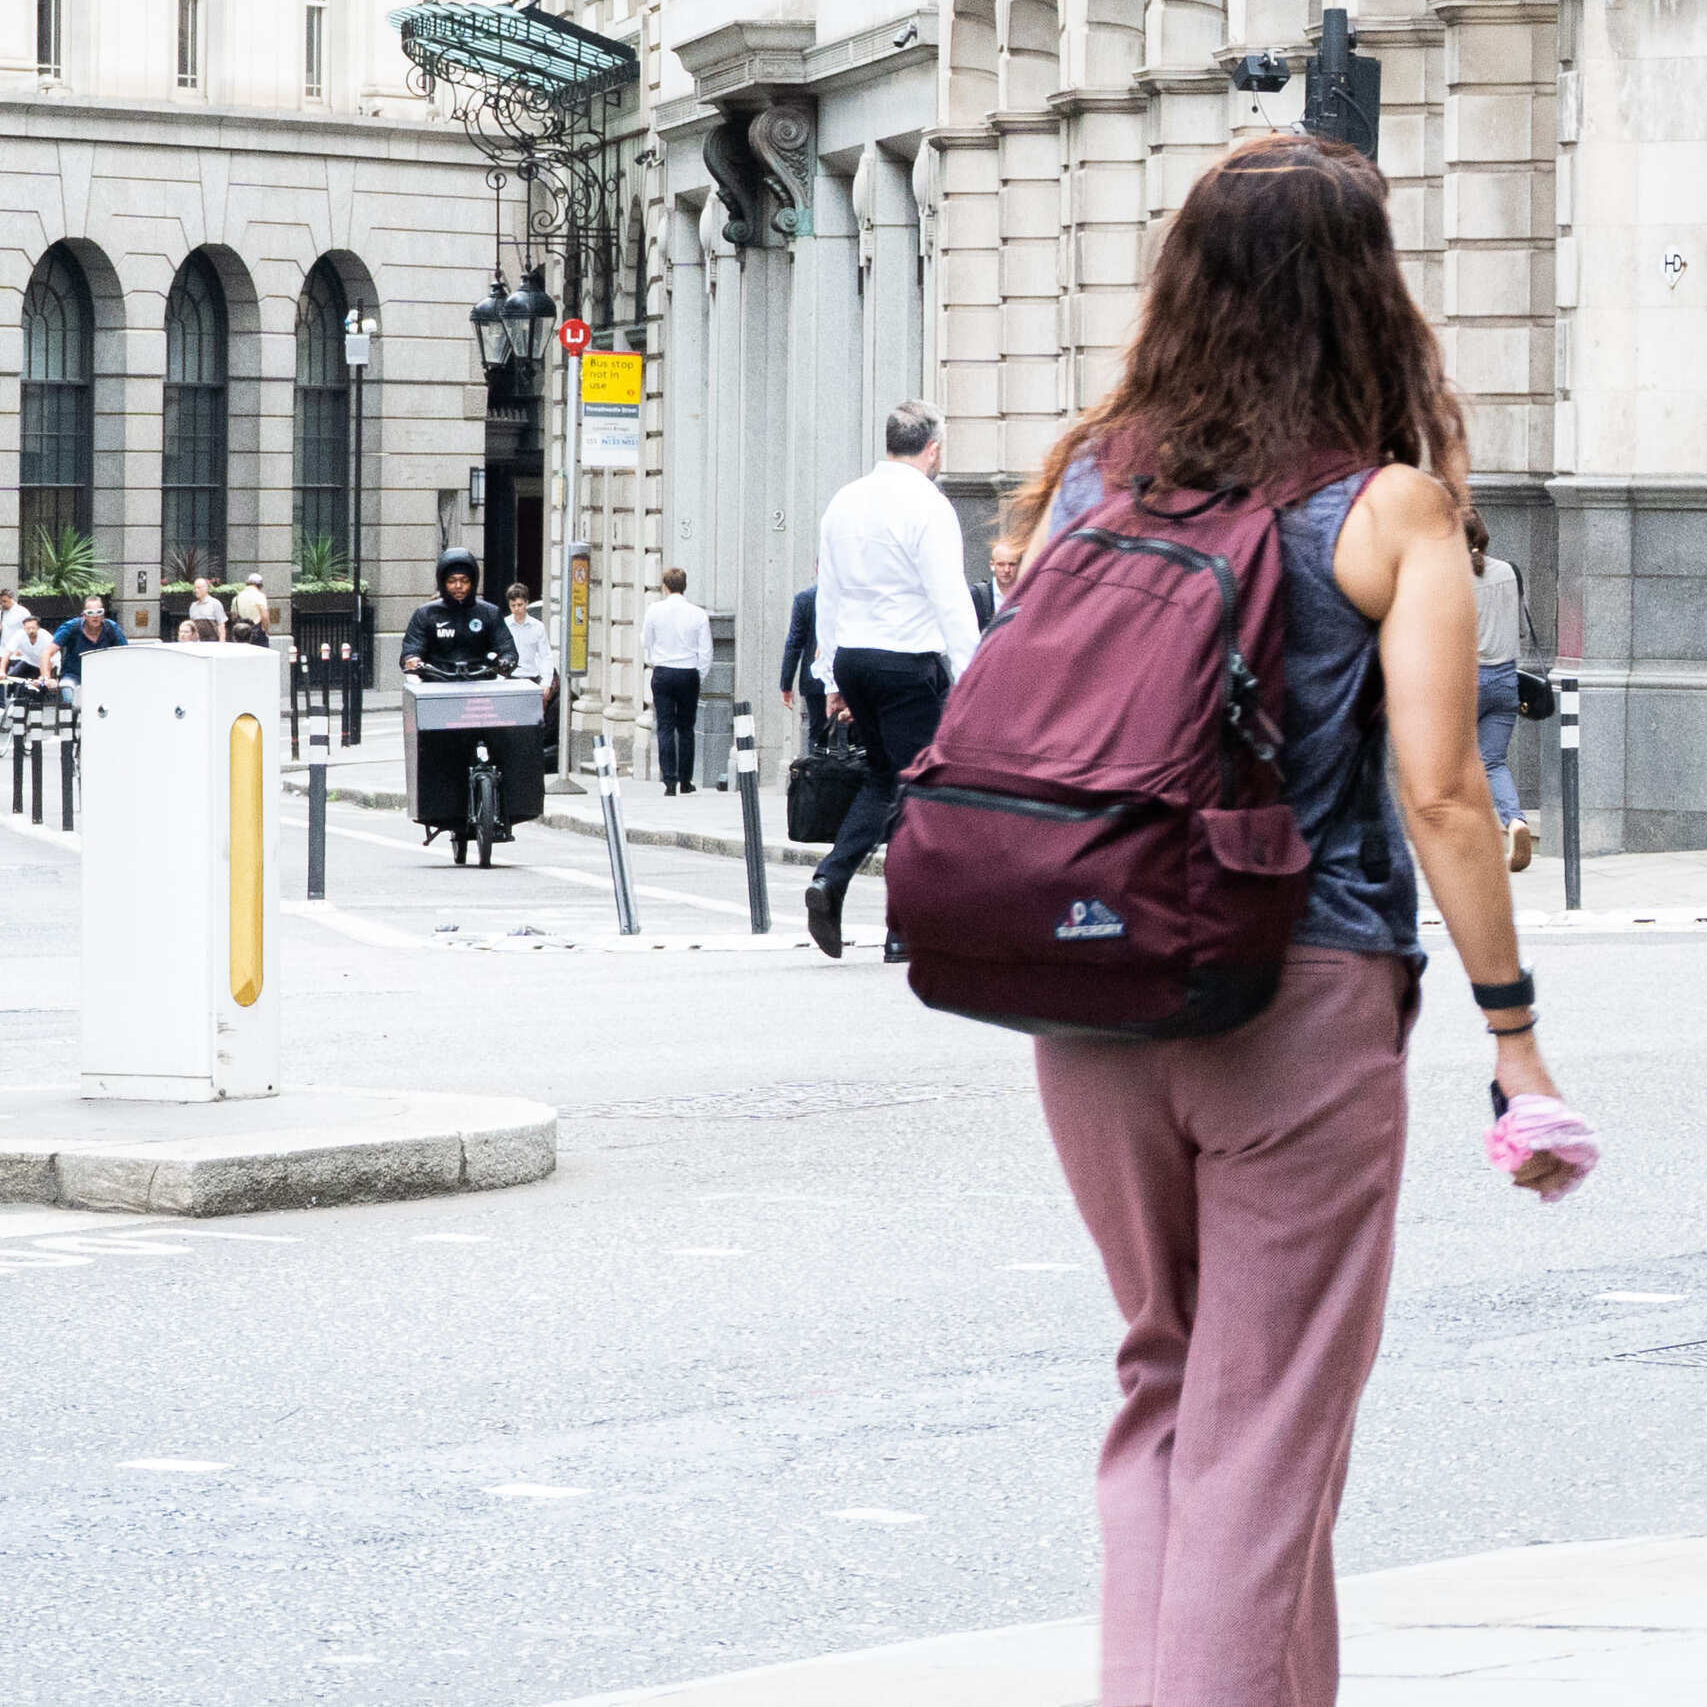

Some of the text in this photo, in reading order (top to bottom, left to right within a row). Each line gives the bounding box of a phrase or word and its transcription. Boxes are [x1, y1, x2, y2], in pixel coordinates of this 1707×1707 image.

[590, 358, 634, 371] Bus stop
[589, 369, 619, 379] not in
[589, 381, 607, 390] use
[772, 509, 786, 532] 2
[680, 518, 693, 540] 3
[436, 628, 456, 638] MW
